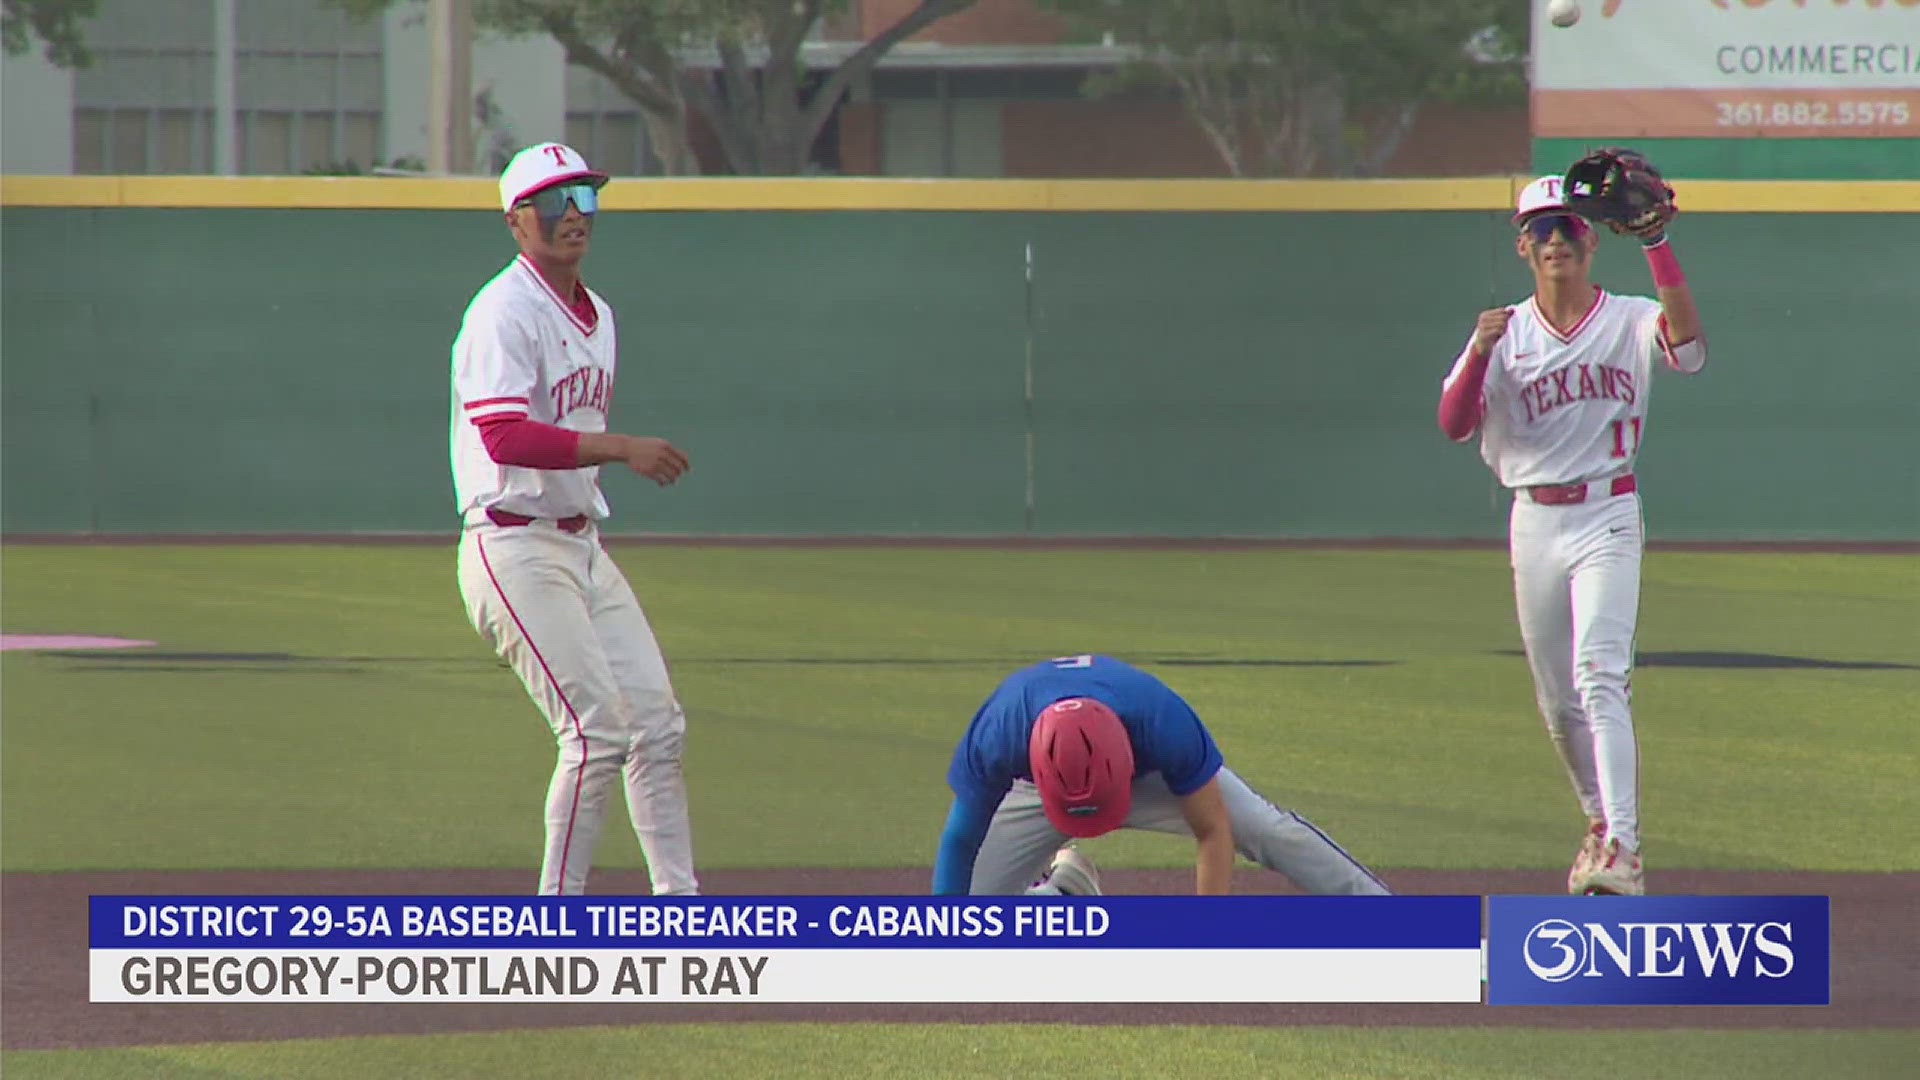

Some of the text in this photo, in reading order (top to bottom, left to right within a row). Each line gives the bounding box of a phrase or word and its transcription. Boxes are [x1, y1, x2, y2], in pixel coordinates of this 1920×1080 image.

[1716, 45, 1920, 74] COMMERCI
[1716, 101, 1910, 126] 361.882.5575
[543, 146, 567, 167] T
[1541, 179, 1561, 199] T
[1521, 363, 1636, 423] TEXANS
[1610, 415, 1641, 459] 11
